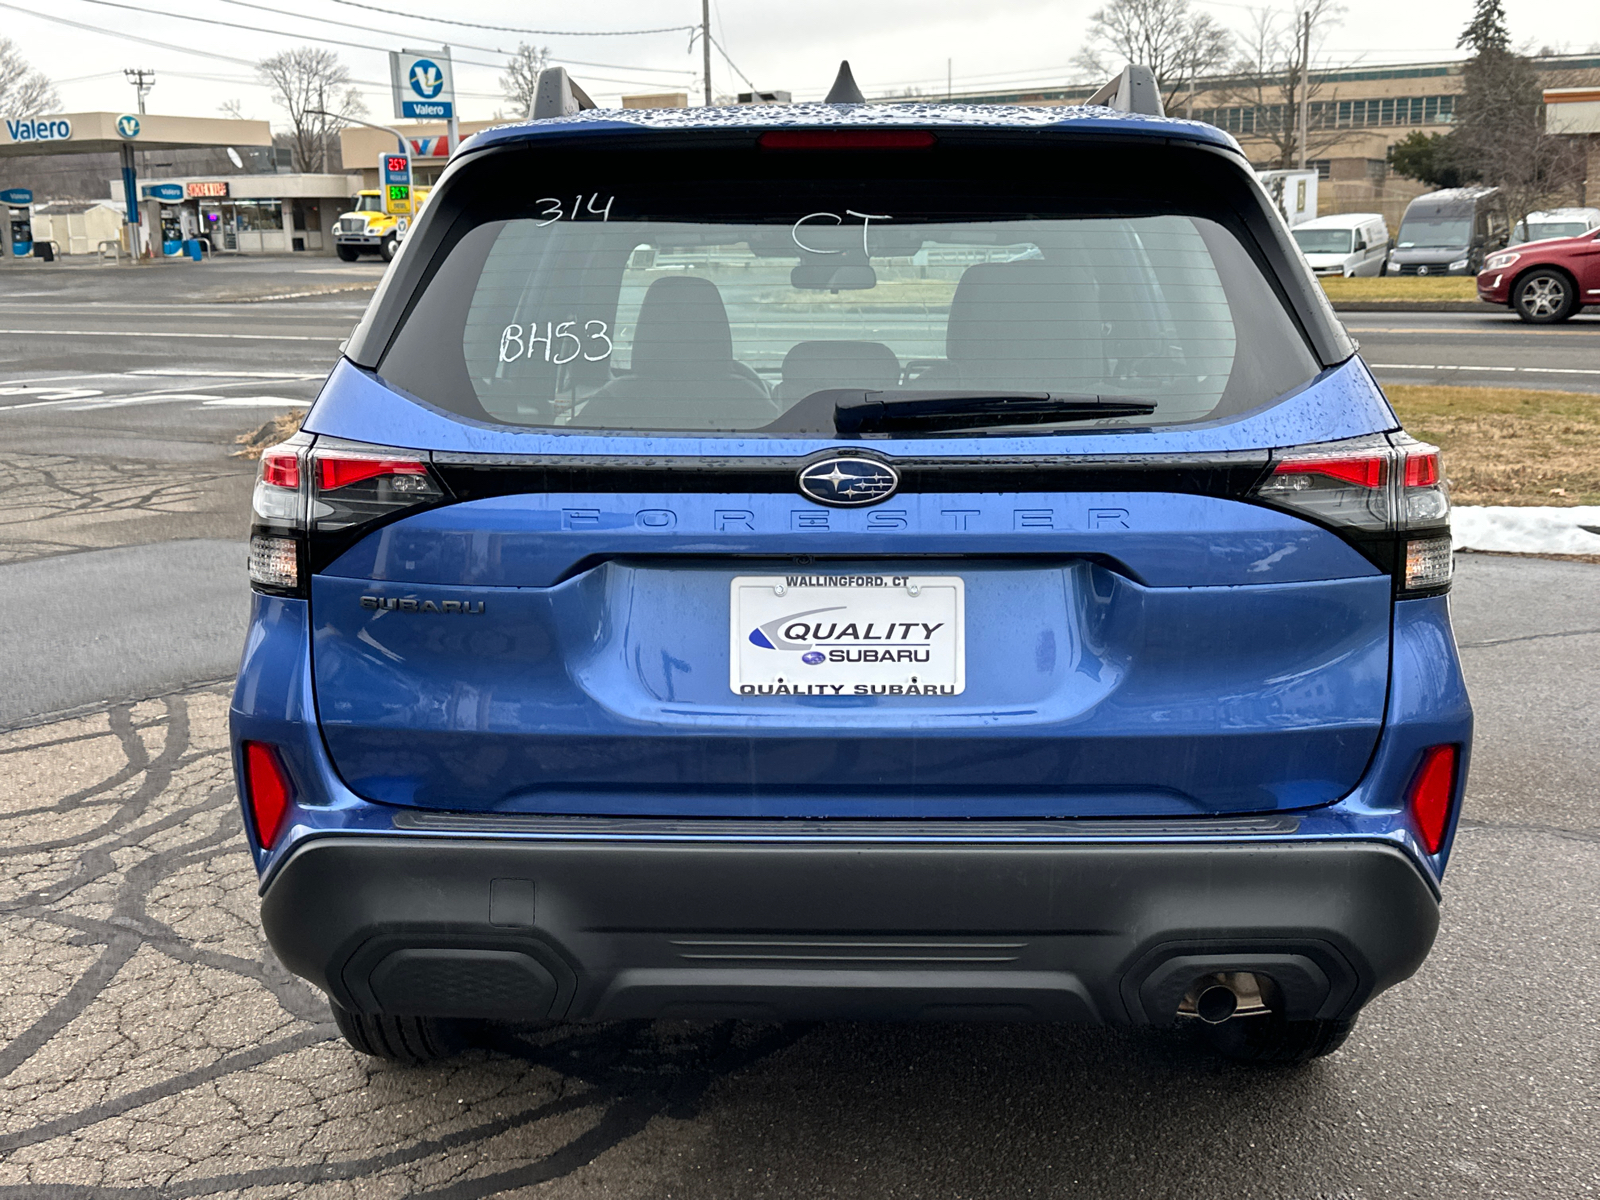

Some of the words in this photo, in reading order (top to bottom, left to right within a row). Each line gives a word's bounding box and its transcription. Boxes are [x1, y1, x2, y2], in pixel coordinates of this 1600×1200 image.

[413, 103, 444, 115] Valero
[6, 119, 70, 140] Valero
[535, 193, 614, 226] 314
[792, 210, 893, 257] CT
[499, 320, 613, 364] BH53
[561, 507, 1131, 532] FORESTER
[786, 576, 888, 588] WALLINGFORD,
[892, 576, 910, 587] CT
[360, 595, 486, 614] SUBARU
[784, 623, 945, 641] QUALITY
[829, 649, 930, 663] SUBARU
[739, 684, 845, 696] QUALITY
[853, 684, 956, 696] SUBARU
